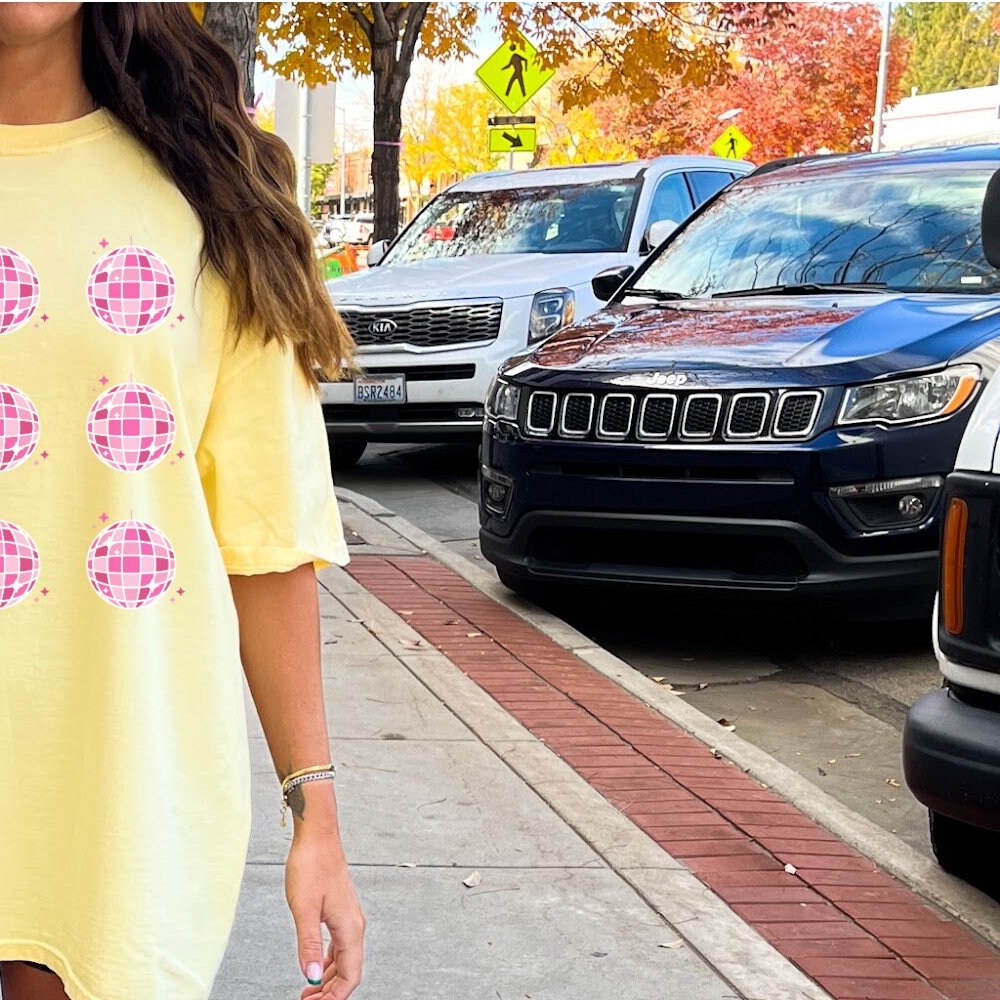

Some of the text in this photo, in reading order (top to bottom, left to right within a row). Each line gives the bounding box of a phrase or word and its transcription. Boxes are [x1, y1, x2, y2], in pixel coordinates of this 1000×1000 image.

[372, 322, 391, 333] KIA
[646, 371, 688, 387] Jeep
[357, 384, 402, 400] BSR2484
